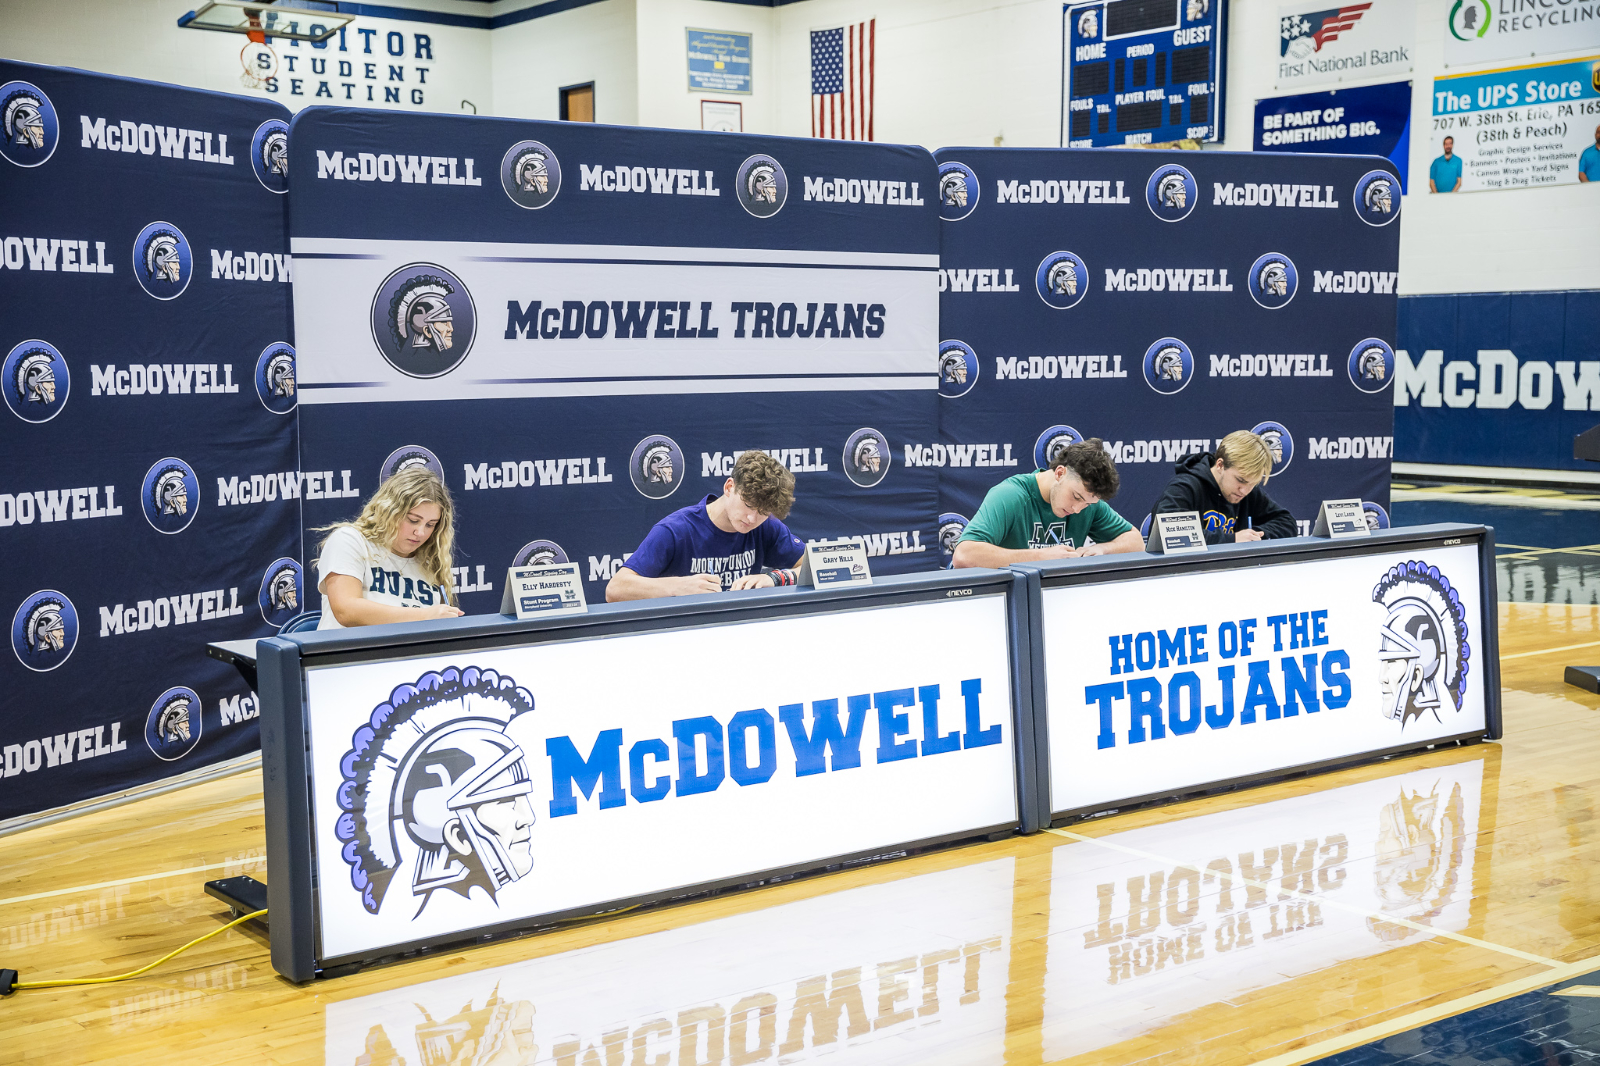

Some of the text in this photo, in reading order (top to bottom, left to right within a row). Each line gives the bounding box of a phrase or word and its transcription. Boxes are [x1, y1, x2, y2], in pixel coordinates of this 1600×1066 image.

[1499, 5, 1600, 33] RECYCLIN
[1173, 25, 1212, 46] GUEST
[1076, 42, 1107, 62] HOME
[1279, 46, 1409, 78] First National Bank
[257, 53, 430, 84] STUDENT
[265, 77, 424, 105] SEATING
[1115, 92, 1145, 105] PLAYER
[1435, 80, 1582, 113] The UPS Store
[1070, 98, 1094, 112] FOULS
[1263, 107, 1345, 130] BE PART OF
[1433, 118, 1454, 131] 707
[1459, 116, 1471, 128] W.
[1477, 113, 1503, 127] 38th
[1507, 111, 1522, 123] St.
[1527, 107, 1552, 121] Erie,
[1558, 104, 1574, 118] PA
[80, 115, 235, 166] McDOWELL
[1262, 121, 1381, 147] SOMETHING BIG.
[1476, 122, 1568, 146] (38th & Peach)
[1507, 146, 1532, 155] Design
[1533, 142, 1564, 151] Services
[316, 150, 482, 187] McDOWELL
[579, 164, 720, 197] McDOWELL
[803, 176, 925, 206] McDOWELL
[996, 180, 1131, 204] McDOWELL
[1213, 182, 1339, 208] McDOWELL
[0, 236, 114, 274] OWELL
[1104, 268, 1234, 292] McDOWELL
[1313, 270, 1399, 294] McDOW
[504, 300, 887, 341] McDOWELL TROJANS
[90, 363, 240, 396] McDOWELL
[995, 355, 1128, 380] McDOWELL
[1209, 354, 1334, 378] McDOWELL
[1308, 436, 1394, 460] McDOW
[463, 456, 613, 491] McDOWELL
[217, 469, 360, 507] McDOWELL
[727, 548, 756, 571] UNION
[823, 556, 837, 564] GARY
[369, 566, 440, 607] HURS
[522, 580, 572, 591] ELLY HARDESTY
[99, 586, 244, 638] McDOWELL
[1108, 609, 1330, 676] HOME OF THE
[1084, 648, 1352, 750] TROJANS
[545, 677, 1003, 819] McDOWELL
